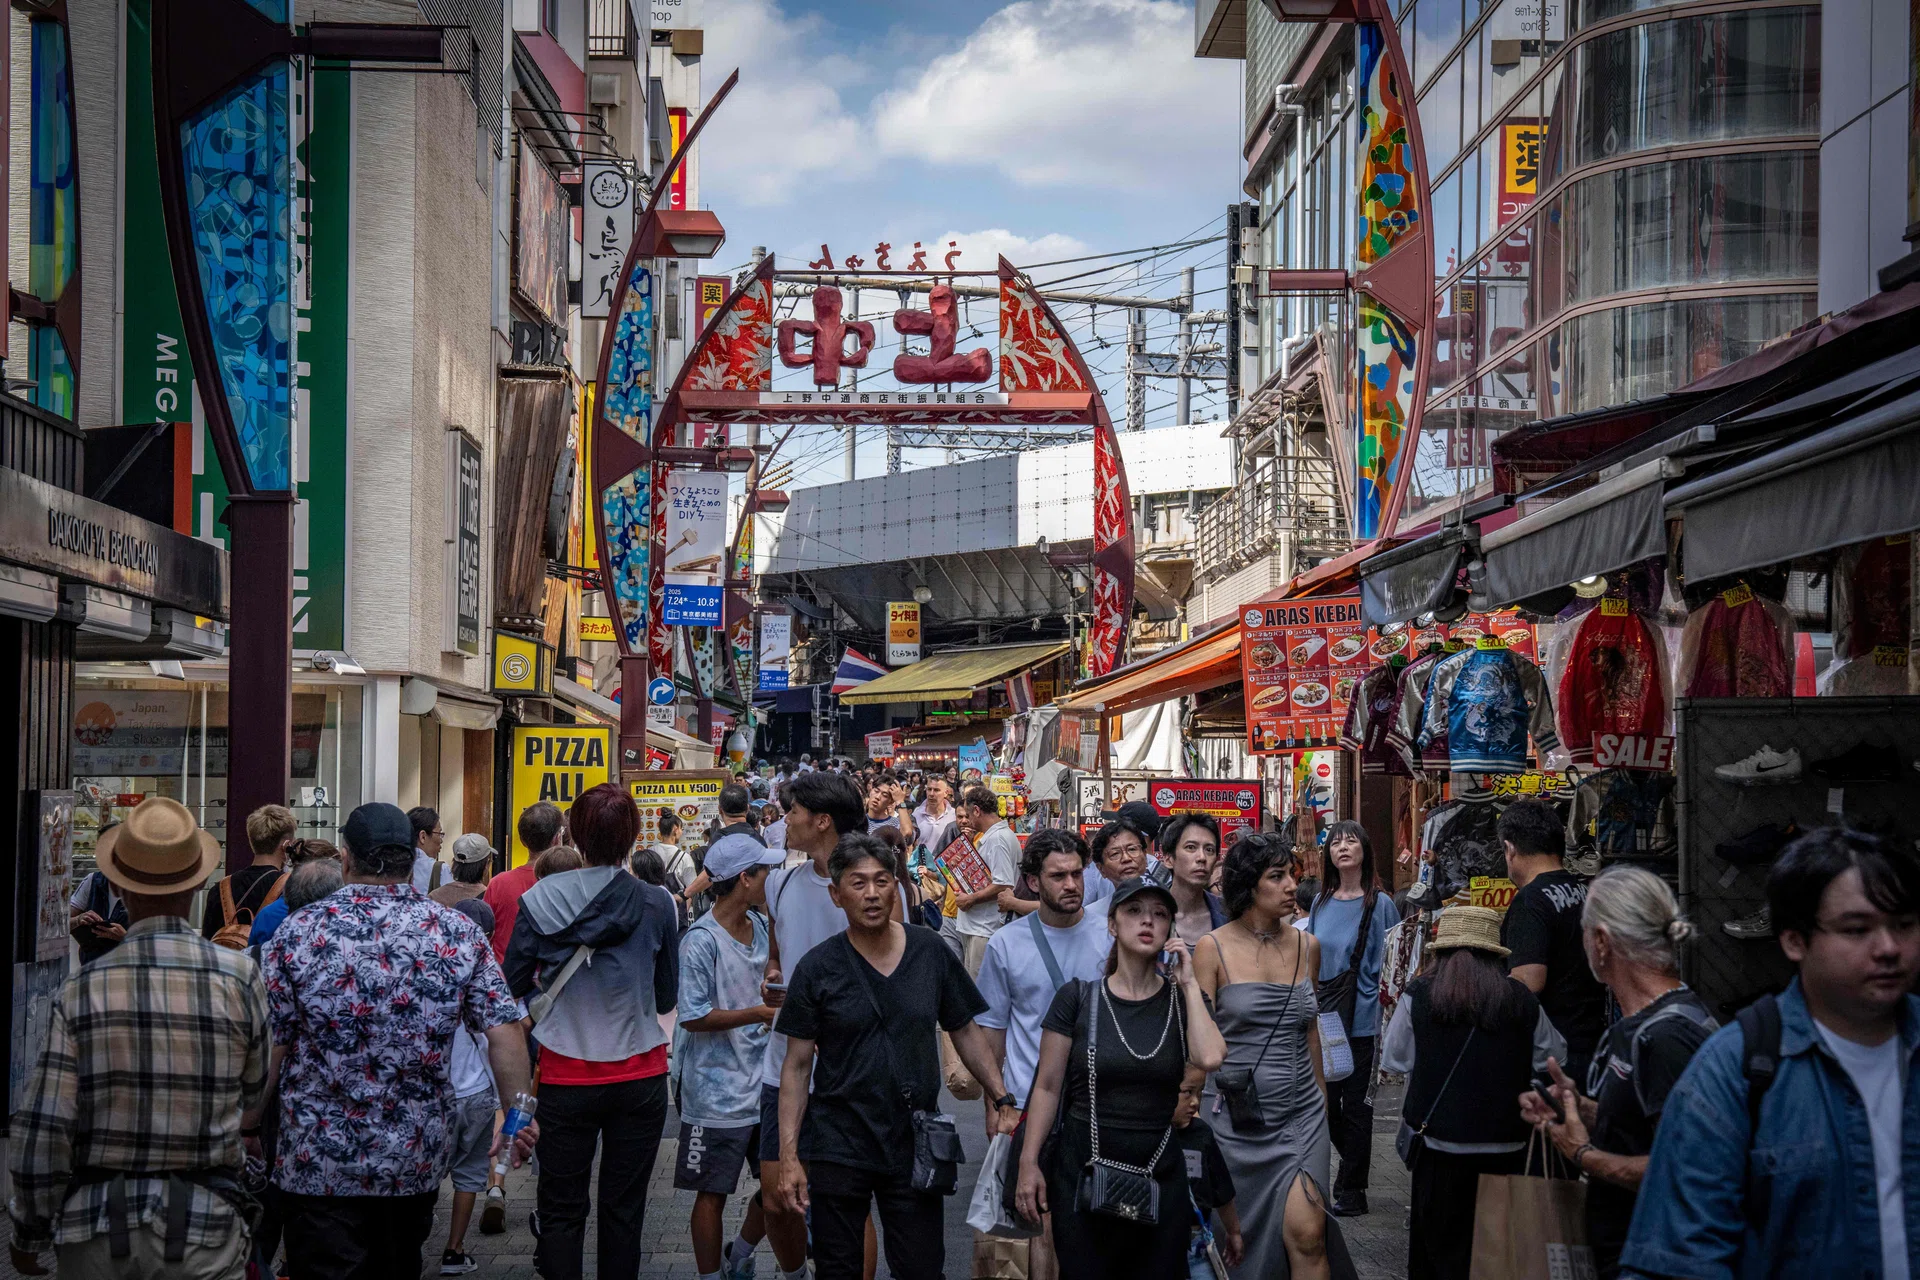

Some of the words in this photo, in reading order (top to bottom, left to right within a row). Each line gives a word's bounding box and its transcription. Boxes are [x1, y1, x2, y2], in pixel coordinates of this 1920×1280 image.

[703, 284, 723, 304] 薬
[155, 332, 179, 424] MEG
[782, 392, 985, 404] 上野中通商店街振興組合
[673, 497, 721, 508] 生きるための
[679, 510, 695, 520] DIY
[891, 610, 918, 621] タイ料理
[1265, 607, 1310, 626] ARAS
[1314, 604, 1361, 624] KEBA
[509, 661, 523, 677] 5
[524, 736, 605, 767] PIZZA
[1599, 733, 1670, 768] SALE
[635, 784, 665, 795] PIZZA
[668, 783, 686, 794] ALL
[1175, 790, 1201, 801] ARAS
[1203, 790, 1235, 802] KEBAB
